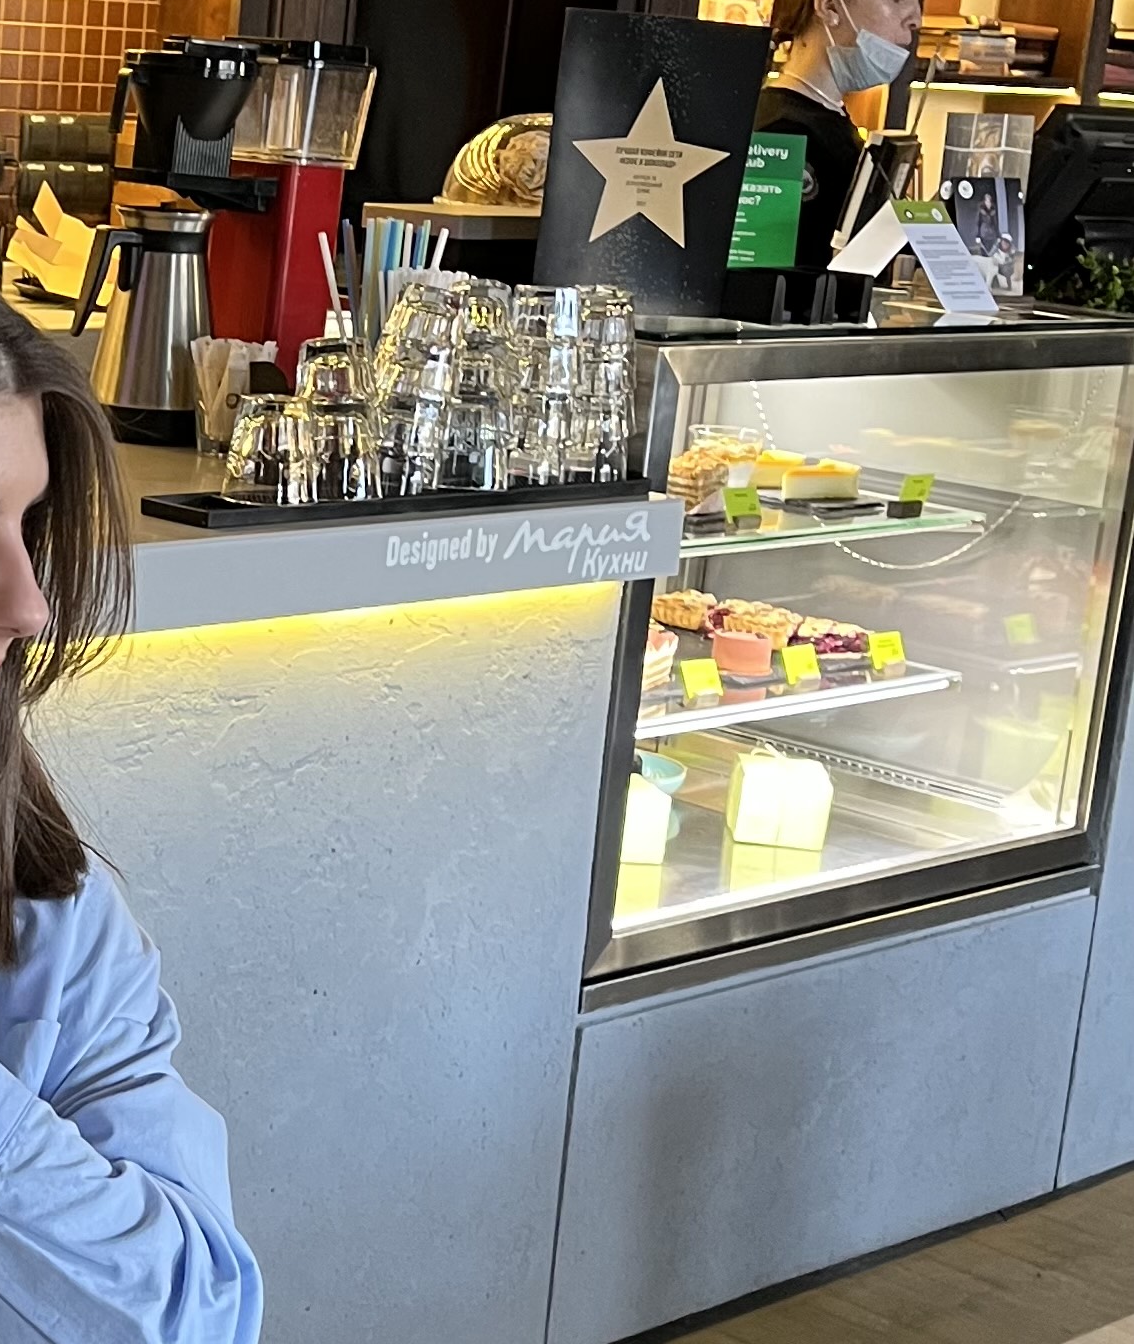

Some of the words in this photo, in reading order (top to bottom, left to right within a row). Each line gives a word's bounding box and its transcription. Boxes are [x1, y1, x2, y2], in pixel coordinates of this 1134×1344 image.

[386, 528, 472, 571] Designed
[476, 527, 498, 563] by
[503, 511, 651, 574] Мария
[581, 548, 649, 579] Кухни
